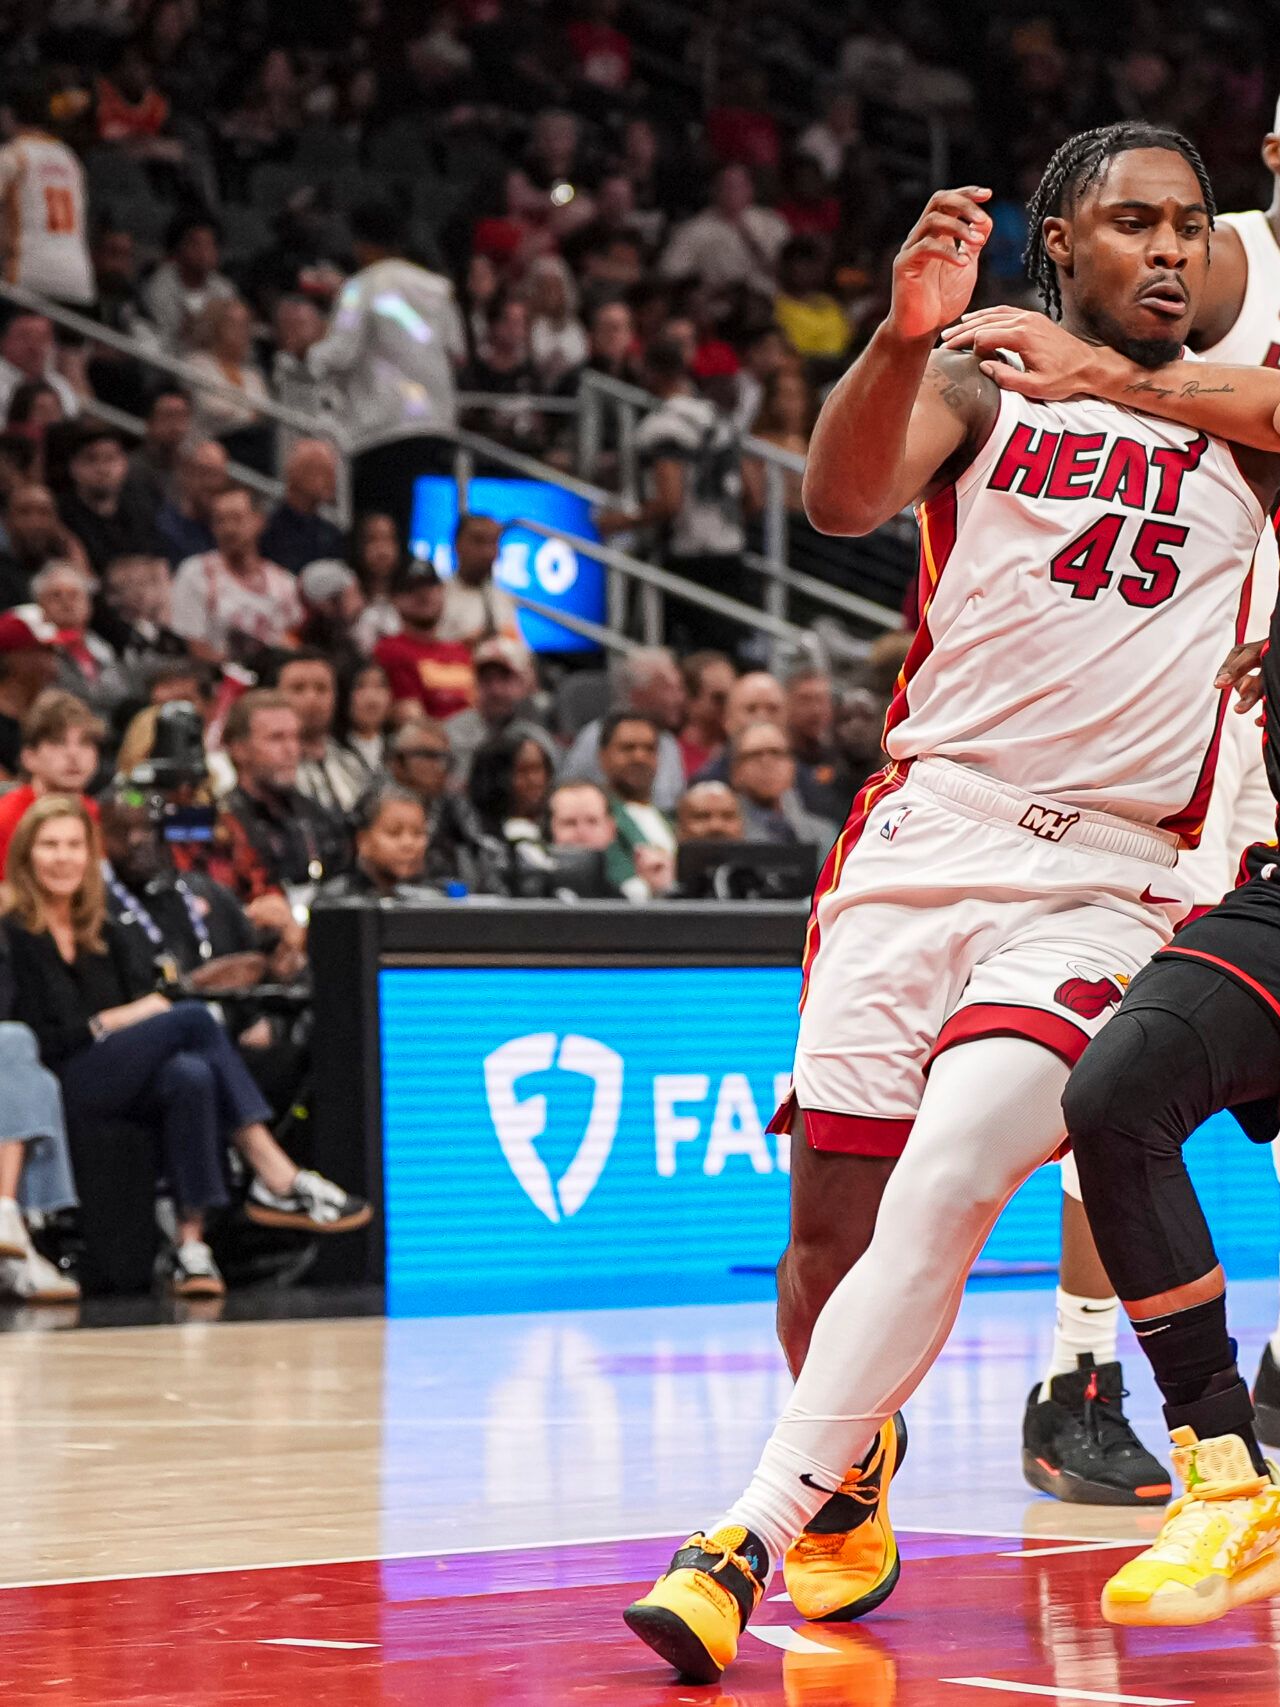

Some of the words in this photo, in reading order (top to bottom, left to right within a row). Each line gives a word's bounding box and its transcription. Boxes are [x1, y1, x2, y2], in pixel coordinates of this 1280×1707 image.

[987, 422, 1208, 516] HEAT
[1050, 513, 1190, 608] 45
[1018, 803, 1081, 842] MH
